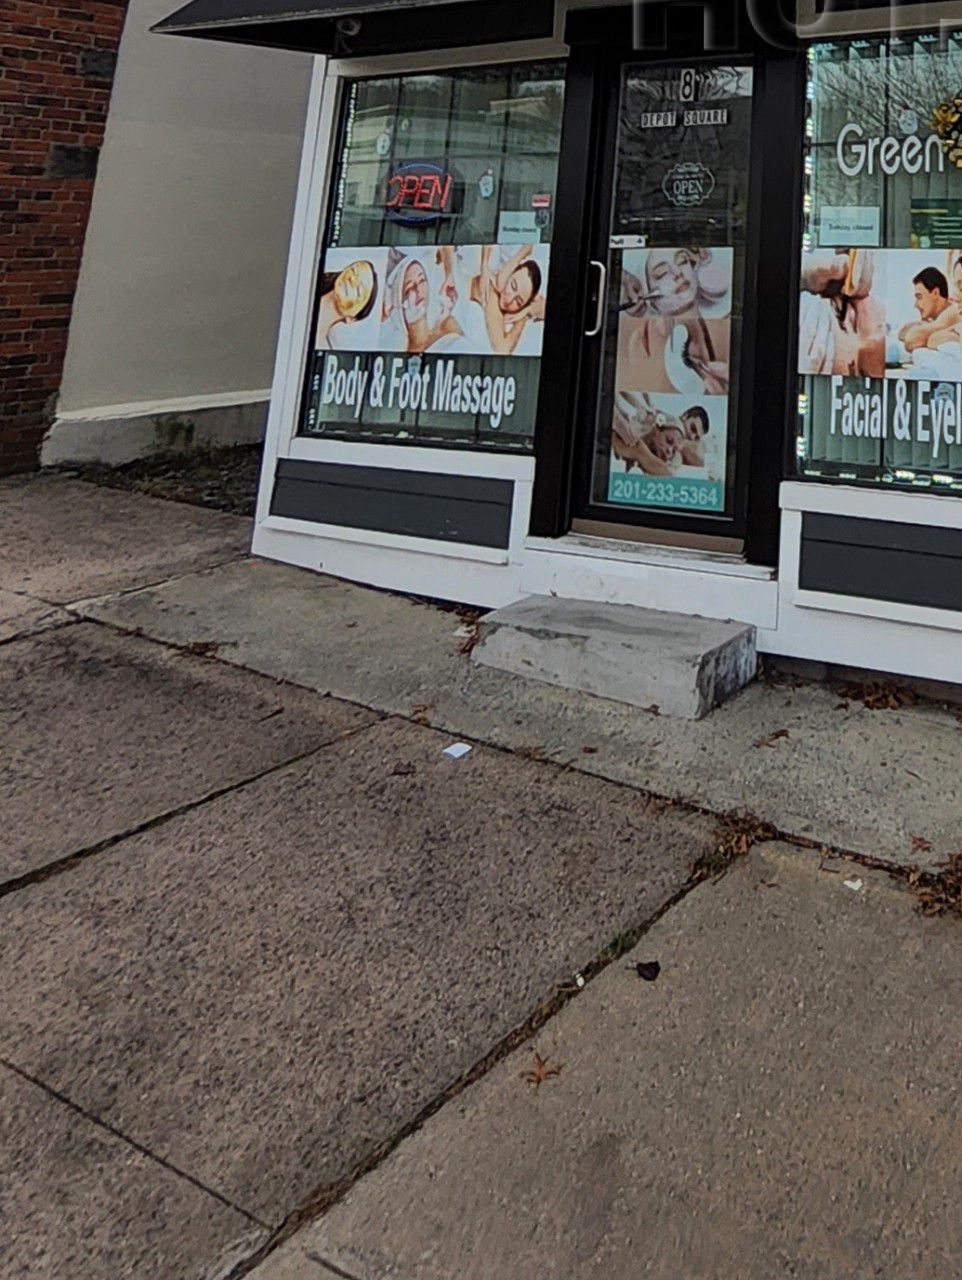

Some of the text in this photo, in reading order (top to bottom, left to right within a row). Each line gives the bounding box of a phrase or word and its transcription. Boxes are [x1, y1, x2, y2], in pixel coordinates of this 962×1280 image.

[681, 71, 693, 100] 8
[643, 109, 727, 127] DEPOT SQUARE
[837, 123, 944, 176] Green
[384, 173, 453, 209] OPEN
[673, 180, 703, 194] OPEN
[322, 355, 516, 428] Body & Foot Massage
[830, 375, 889, 438] Facial
[893, 379, 912, 440] &
[613, 479, 718, 506] 201-233-5364
